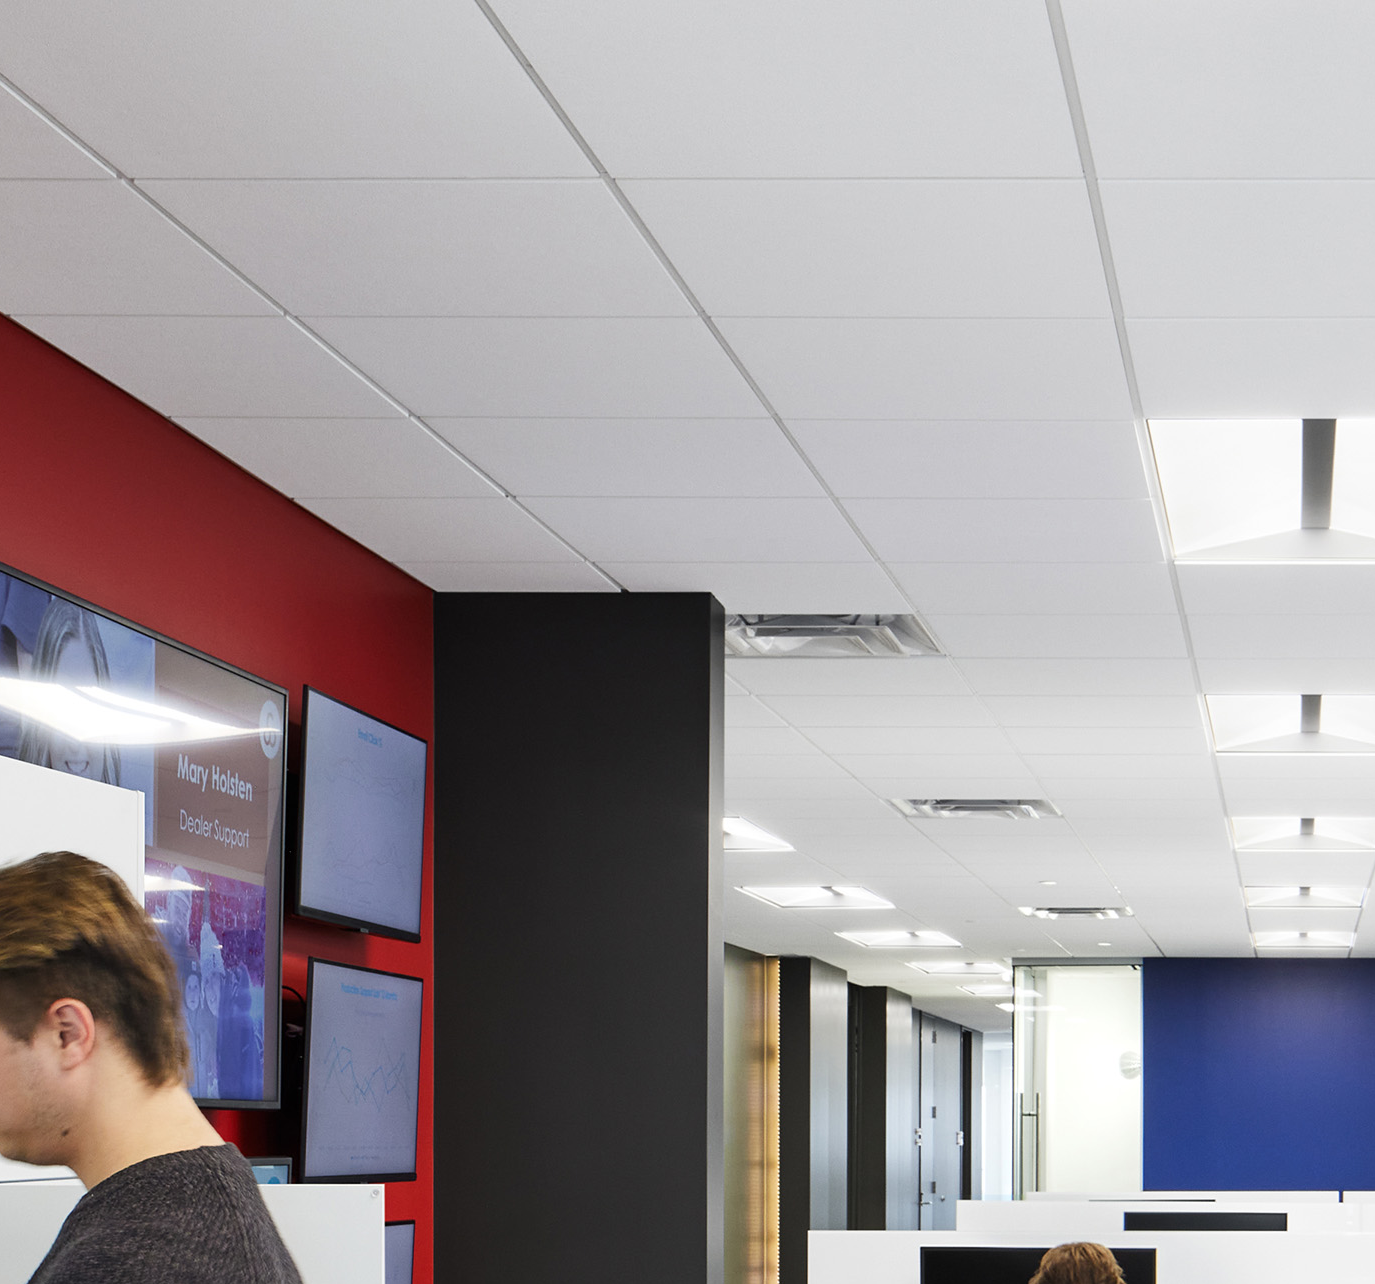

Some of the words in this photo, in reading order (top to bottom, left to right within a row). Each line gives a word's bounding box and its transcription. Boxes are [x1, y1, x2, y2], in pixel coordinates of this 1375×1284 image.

[177, 753, 209, 792] Mary
[211, 764, 253, 802] Holsten
[179, 808, 212, 838] Dealer
[213, 818, 250, 849] Support
